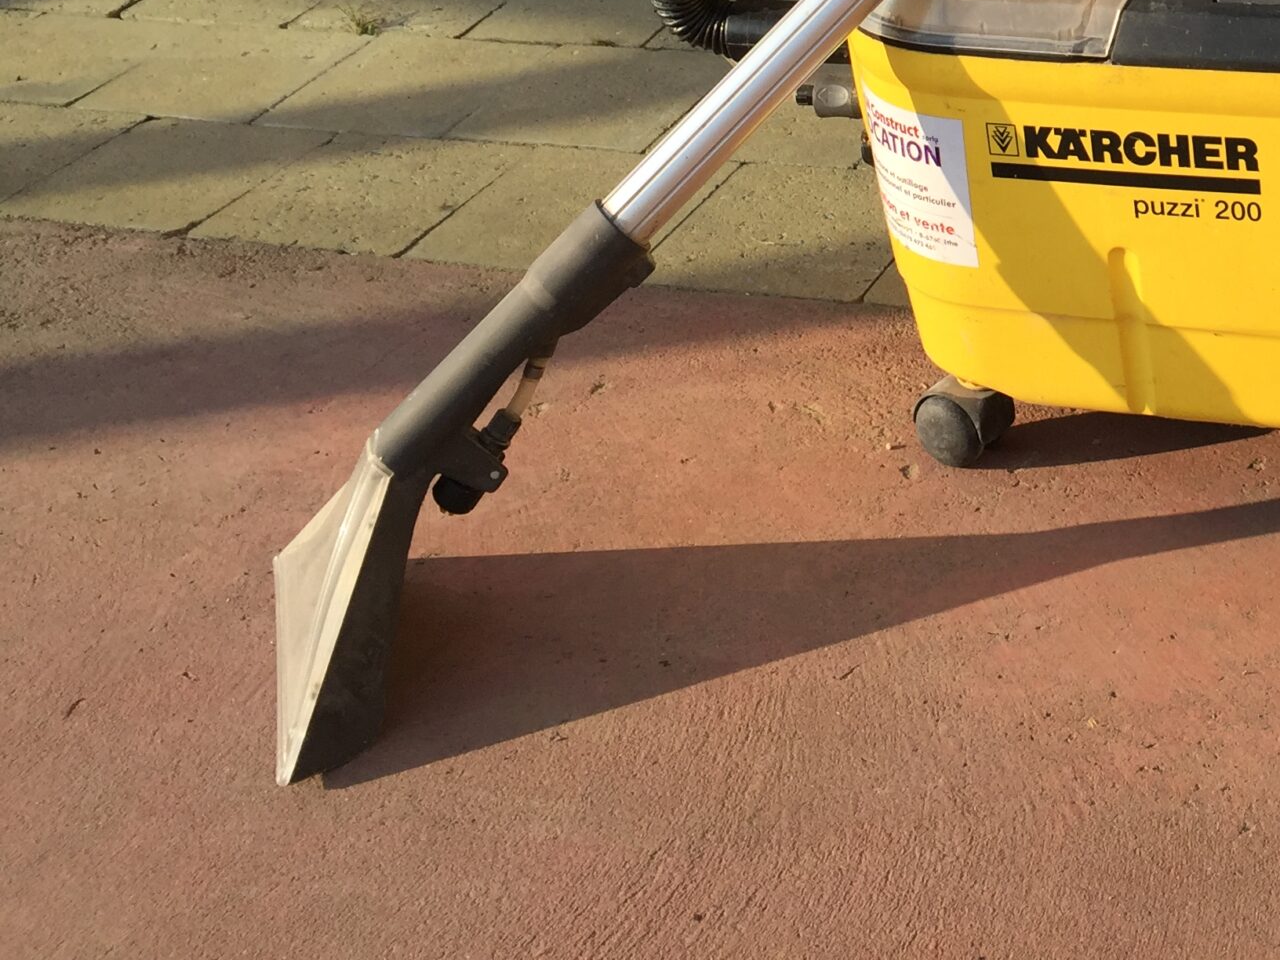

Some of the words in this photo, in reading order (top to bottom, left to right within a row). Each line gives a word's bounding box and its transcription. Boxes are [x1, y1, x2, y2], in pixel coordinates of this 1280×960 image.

[1023, 125, 1260, 172] KÄRCHER
[912, 192, 957, 209] particulier
[1133, 198, 1200, 219] puzzi
[1214, 199, 1262, 222] 200
[914, 216, 955, 236] vente
